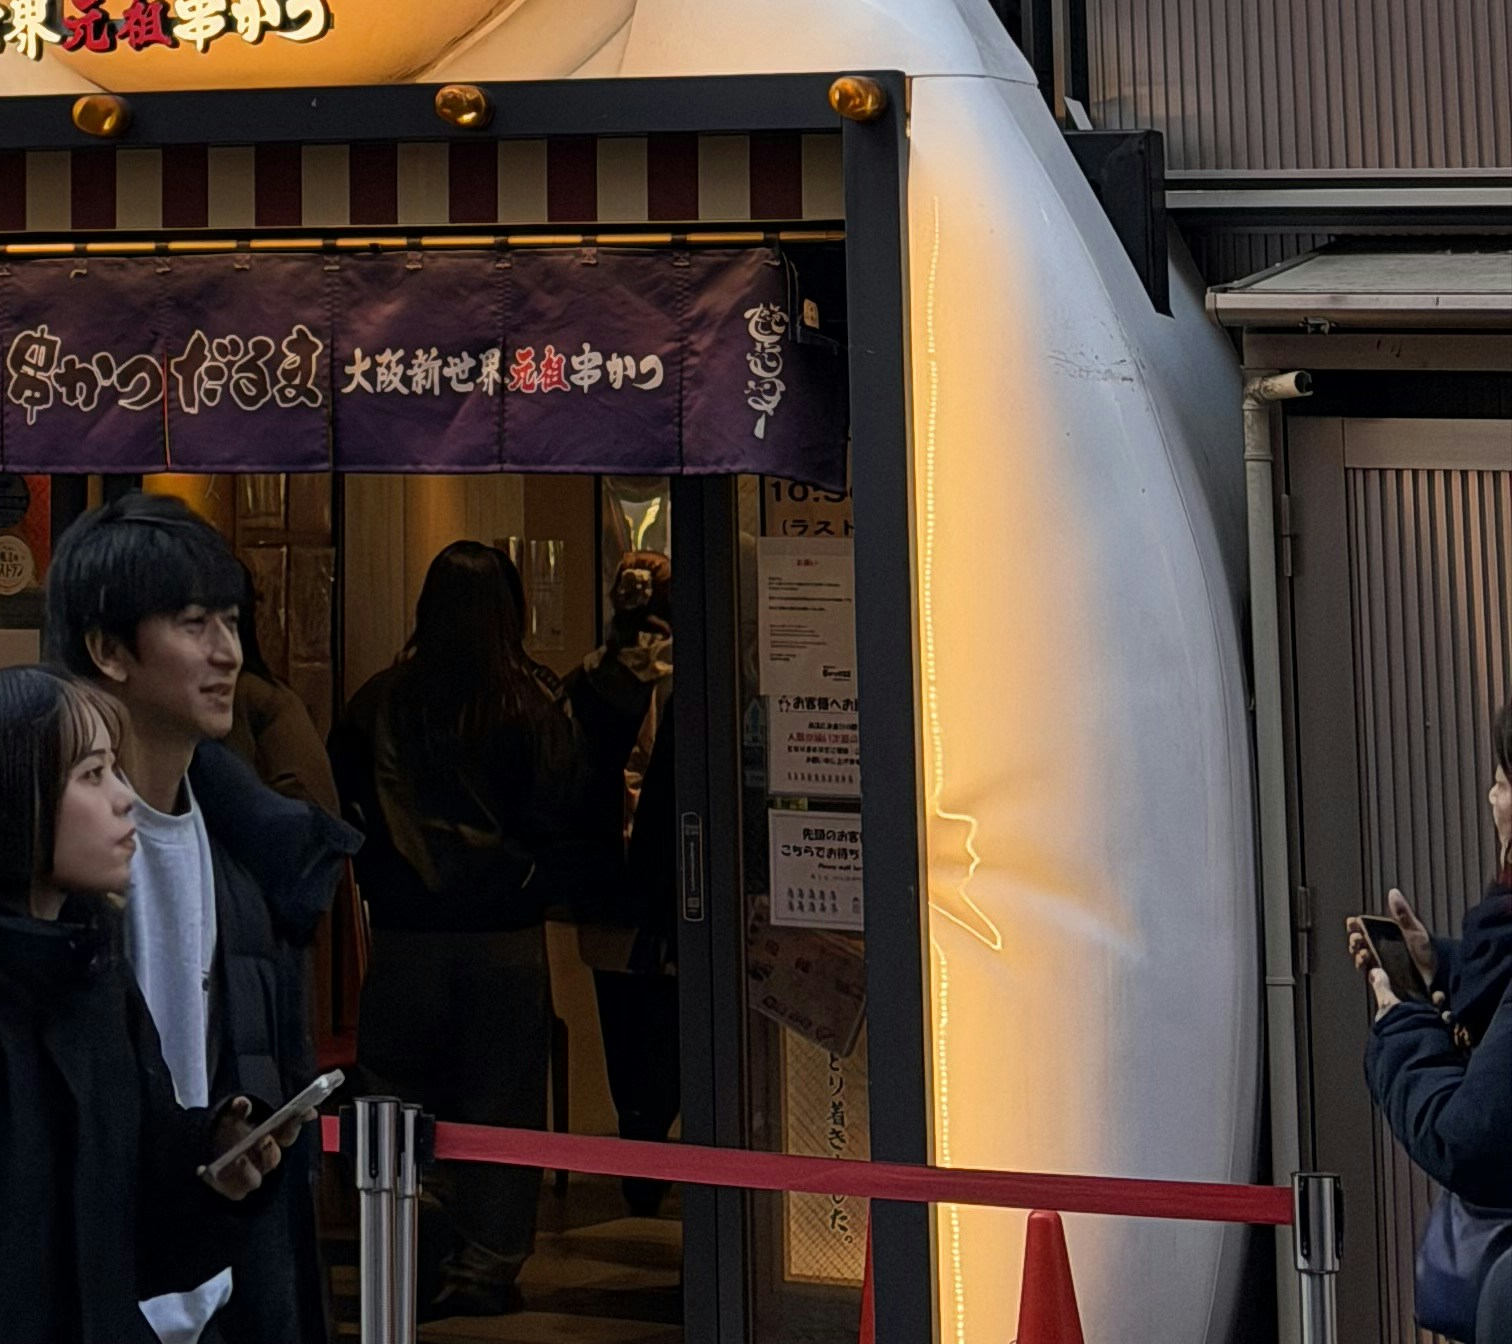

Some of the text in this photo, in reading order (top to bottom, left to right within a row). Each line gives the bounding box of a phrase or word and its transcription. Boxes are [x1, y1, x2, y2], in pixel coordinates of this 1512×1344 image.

[7, 324, 324, 426] 串かつだるま
[341, 343, 664, 398] 大阪新世界元祖串かつ
